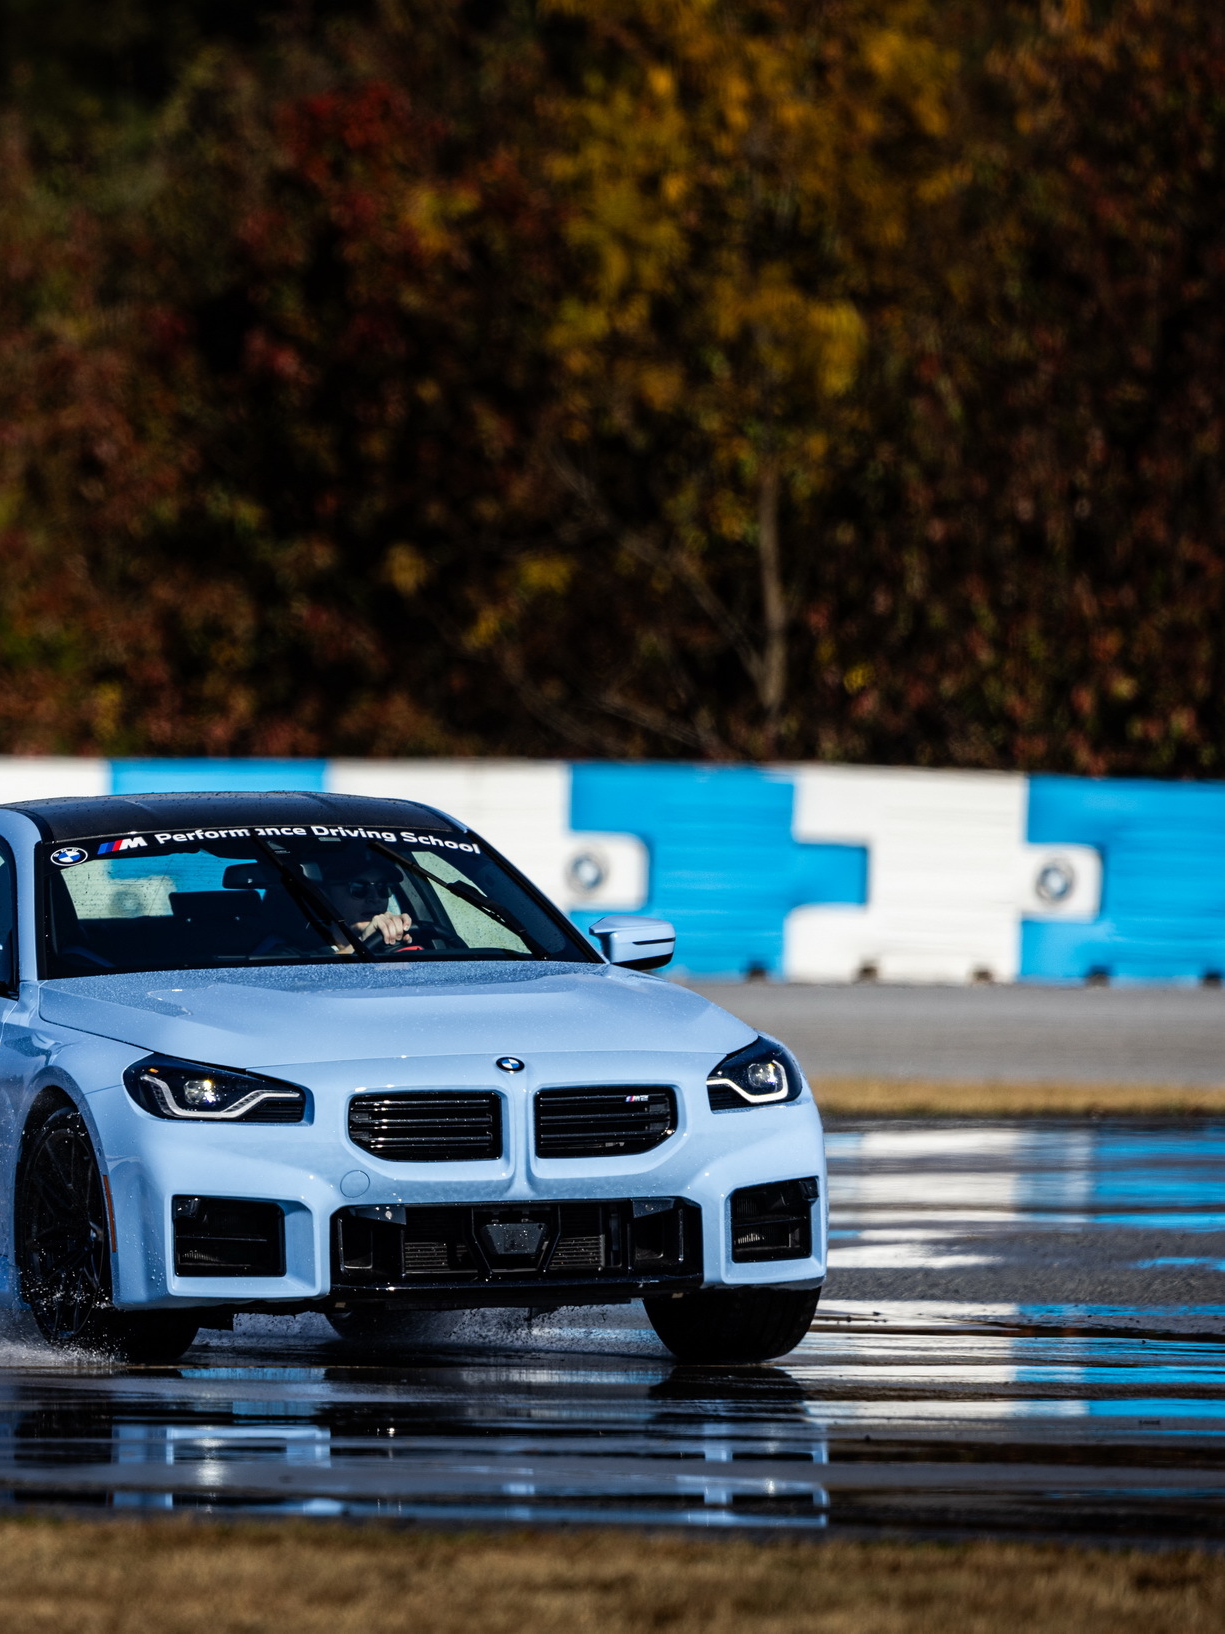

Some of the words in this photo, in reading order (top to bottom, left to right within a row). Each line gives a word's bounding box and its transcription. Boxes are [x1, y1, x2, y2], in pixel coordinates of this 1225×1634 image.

[154, 826, 307, 845] Performance
[310, 825, 397, 843] Driving
[400, 831, 481, 854] School
